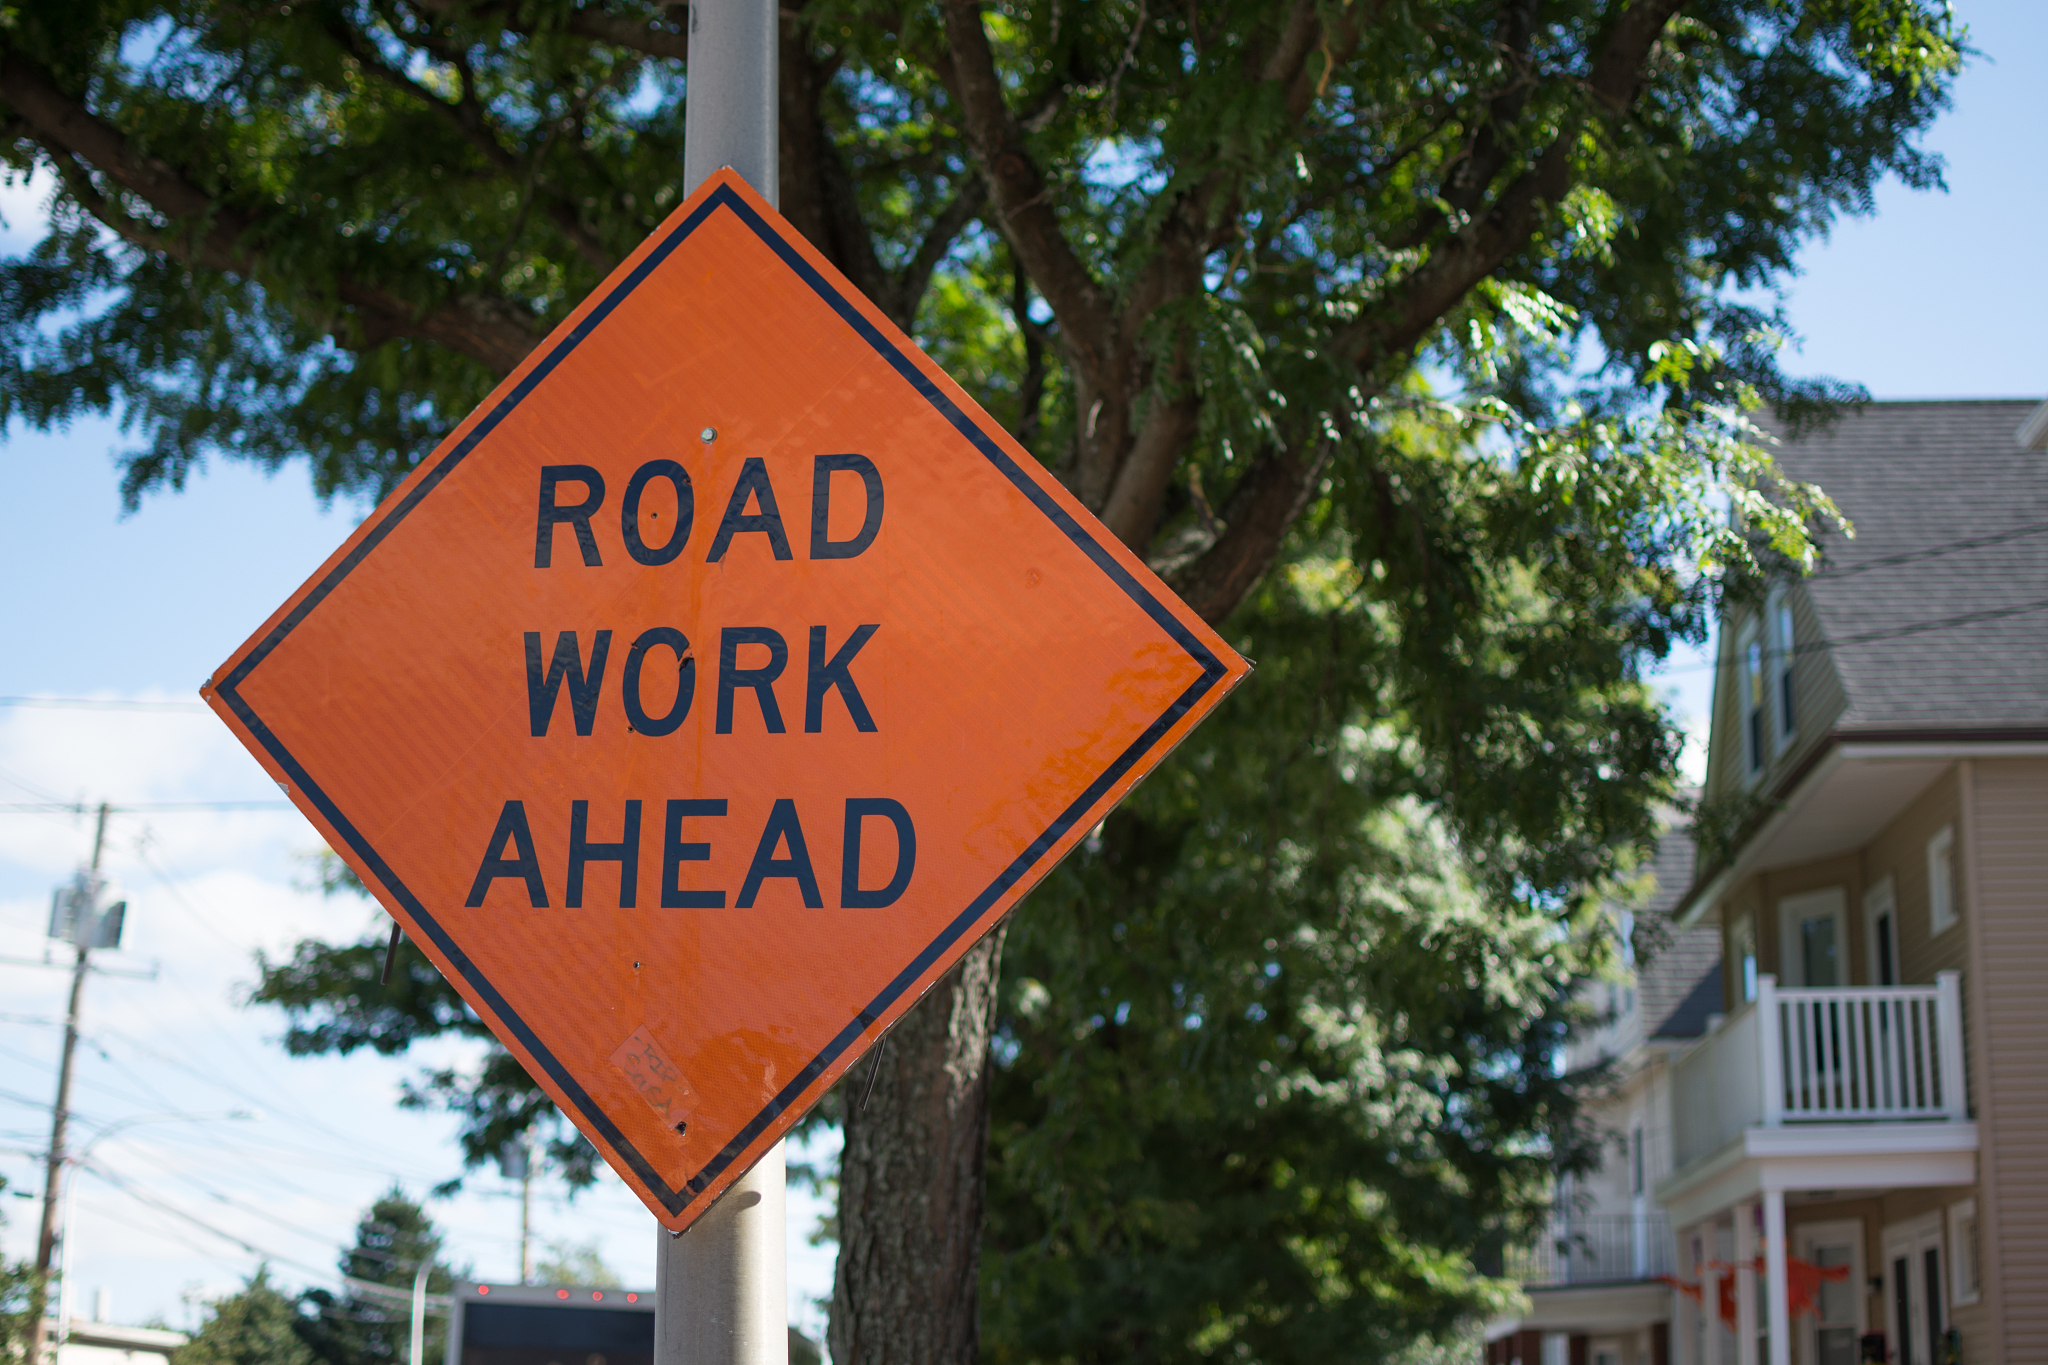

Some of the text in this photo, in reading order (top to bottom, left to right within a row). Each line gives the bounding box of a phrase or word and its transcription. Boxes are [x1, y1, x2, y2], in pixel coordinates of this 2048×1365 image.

[534, 454, 884, 568] ROAD
[524, 624, 881, 737] WORK
[465, 798, 916, 908] AHEAD
